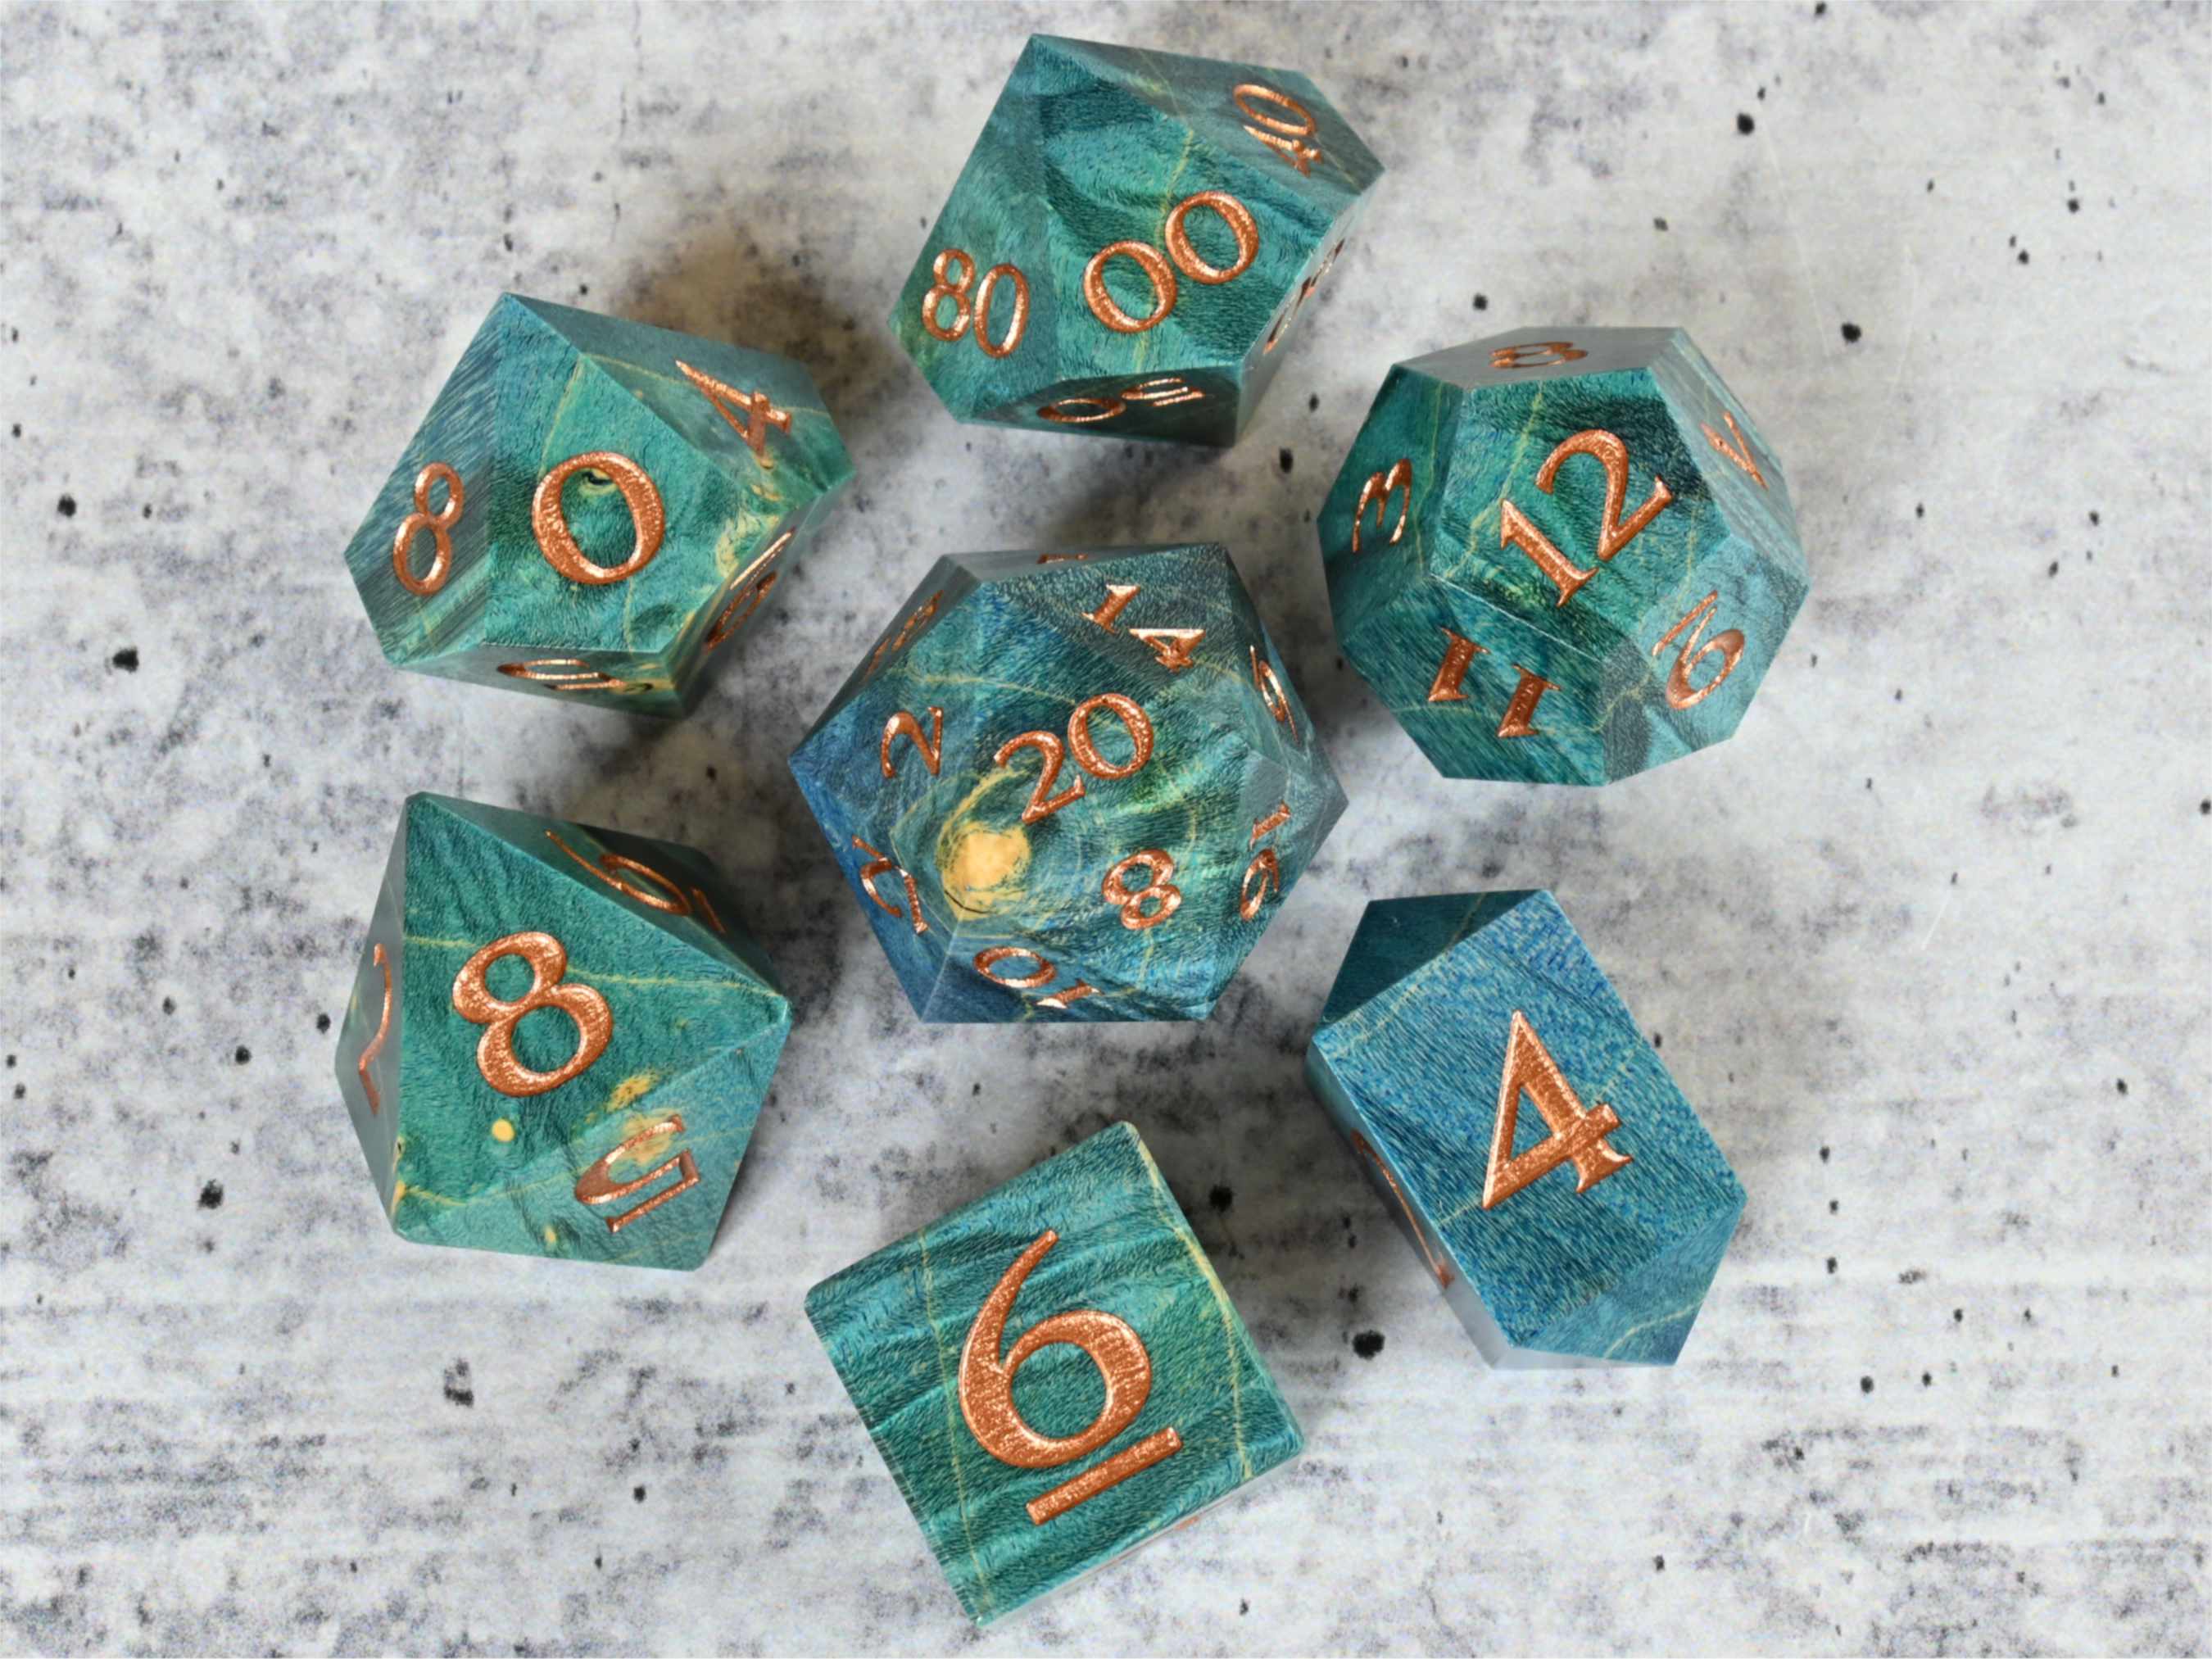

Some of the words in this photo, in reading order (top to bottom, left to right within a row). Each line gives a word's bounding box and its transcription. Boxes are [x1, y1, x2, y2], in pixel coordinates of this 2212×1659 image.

[922, 248, 1030, 358] 80
[1084, 191, 1259, 333] 00
[676, 360, 791, 458] 4
[392, 462, 464, 596] 8
[531, 451, 665, 584] 0
[1352, 458, 1412, 552] 3
[1500, 428, 1674, 606] 12
[1082, 585, 1206, 671] 14
[1427, 628, 1561, 737] 11
[879, 706, 944, 777] 2
[994, 692, 1154, 825] 20
[1101, 849, 1181, 930] 8
[452, 931, 614, 1098] 8
[1481, 1009, 1634, 1210] 4
[575, 1114, 700, 1232] 5
